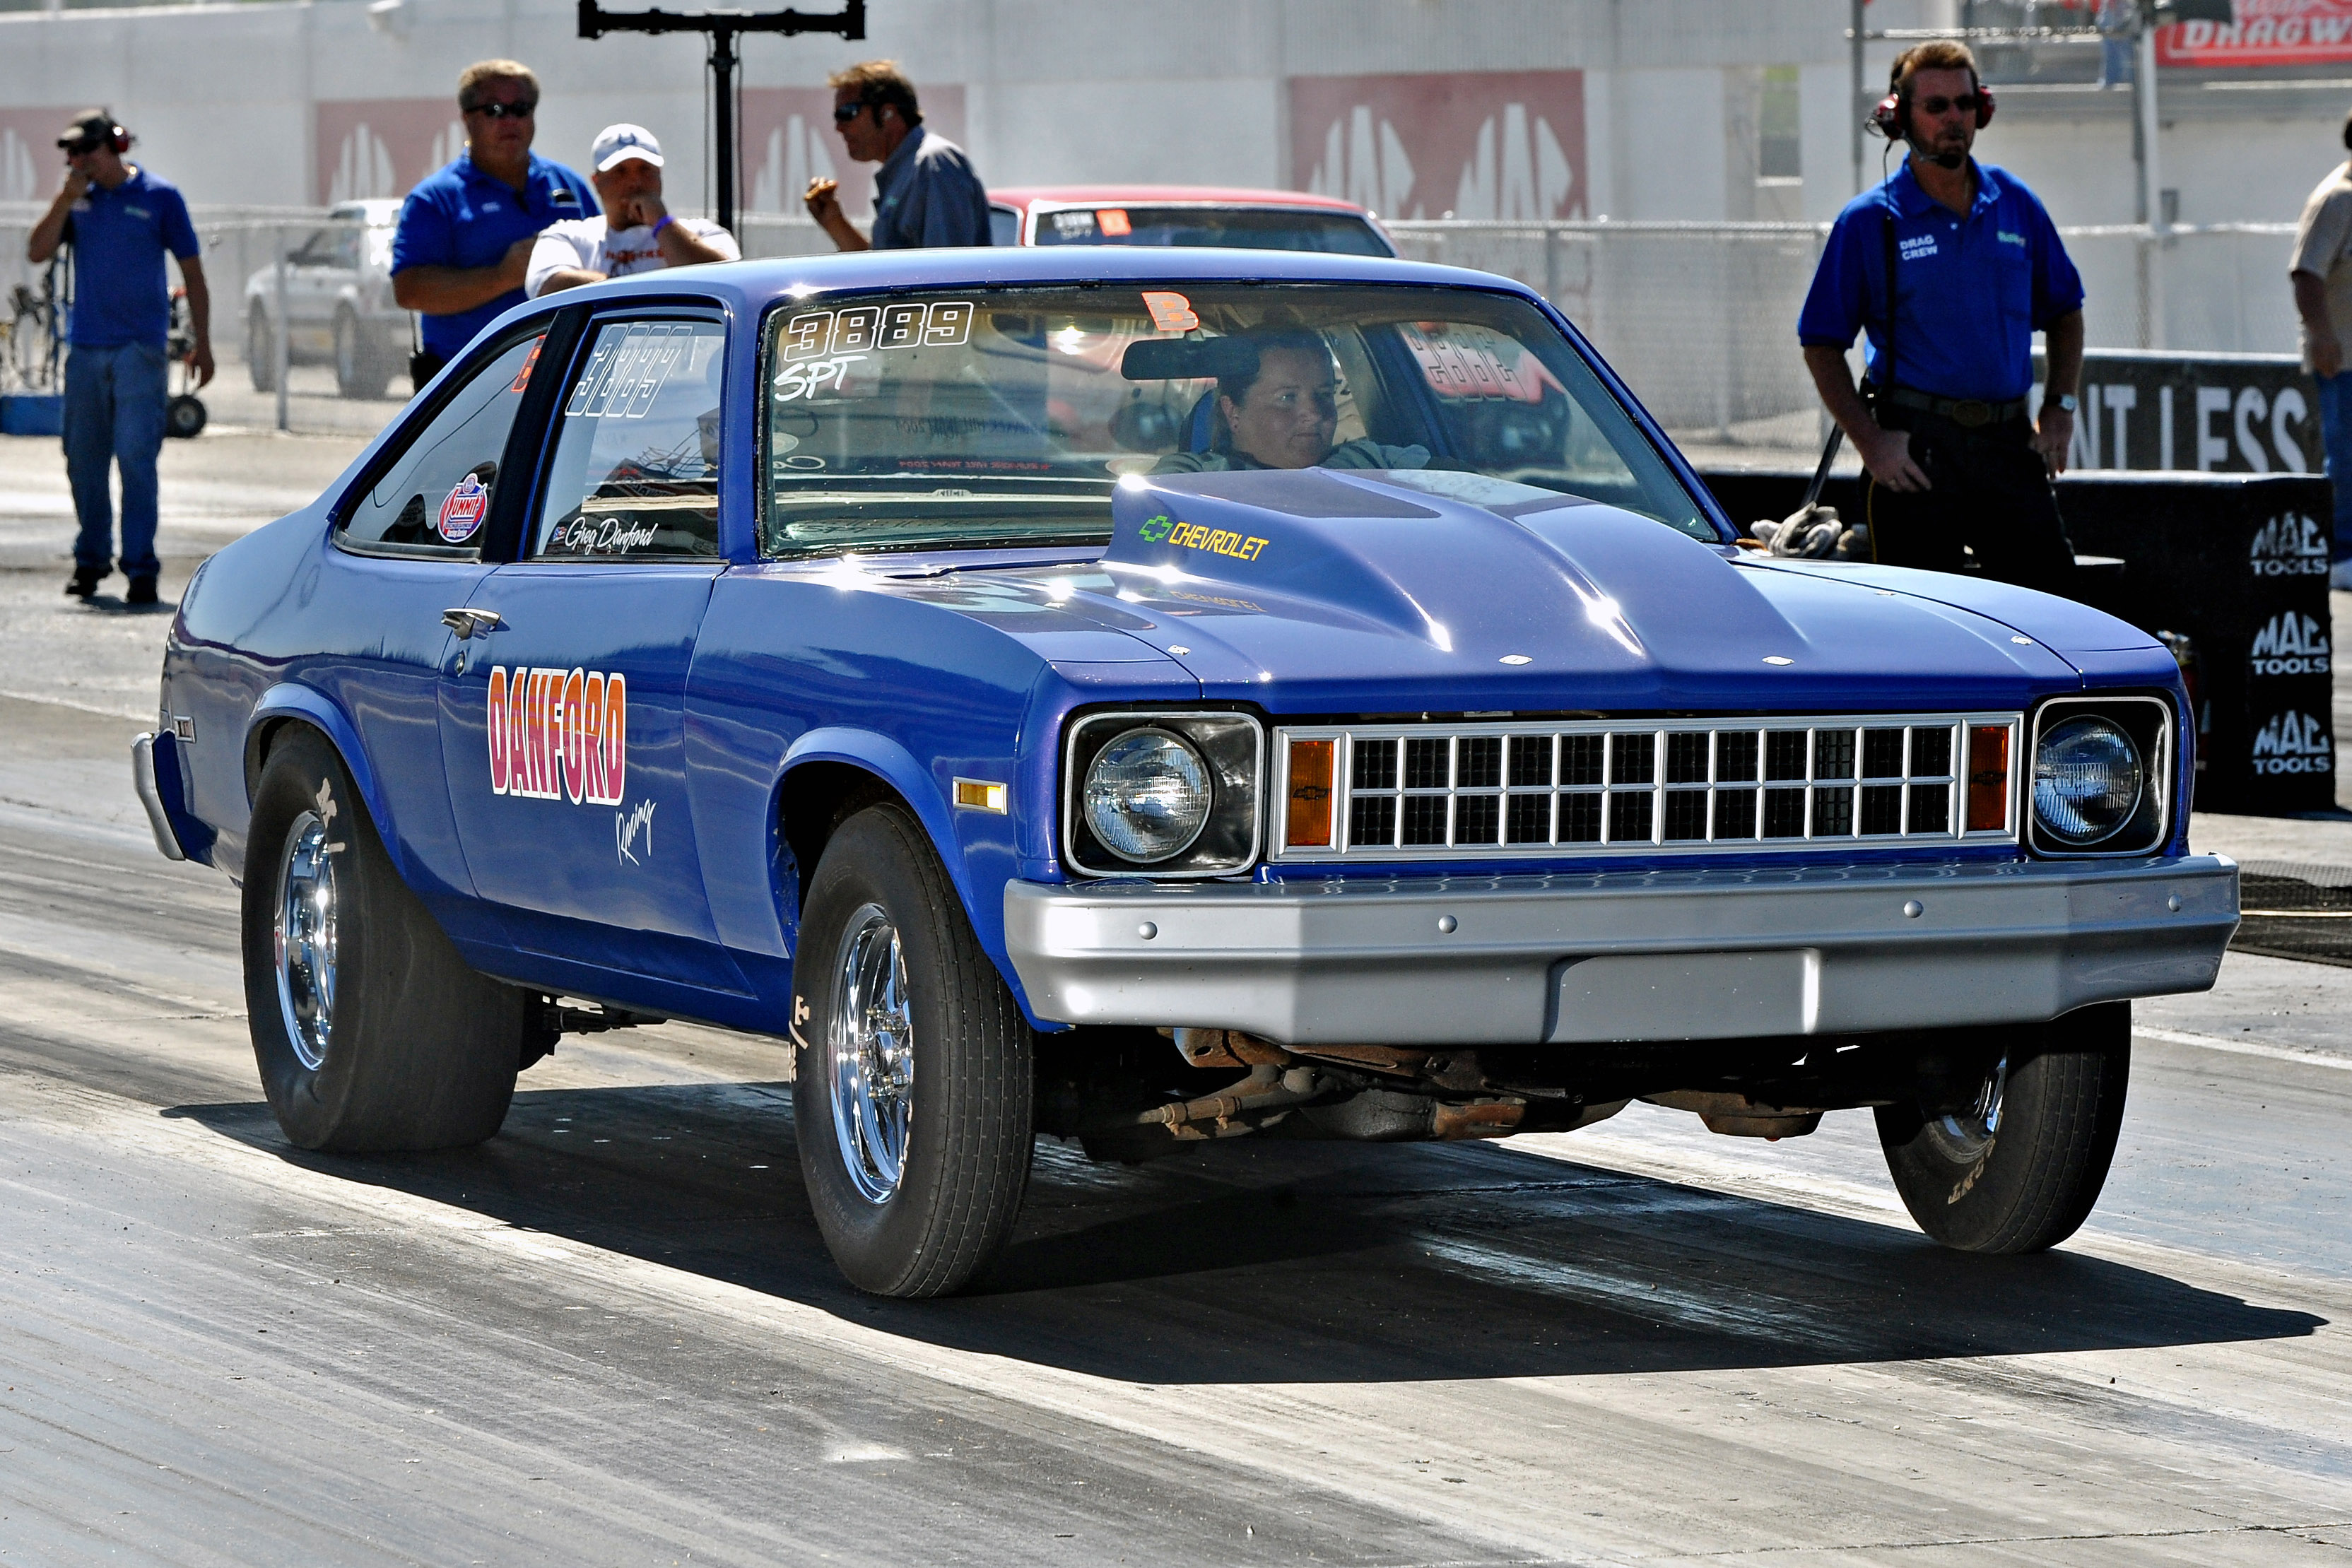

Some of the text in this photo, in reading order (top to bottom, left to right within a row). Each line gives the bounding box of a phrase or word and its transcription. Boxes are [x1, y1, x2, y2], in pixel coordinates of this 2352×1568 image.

[1899, 235, 1934, 251] DRAG
[1902, 245, 1938, 261] CREW
[784, 302, 974, 362] 3889
[1141, 291, 1200, 331] B
[565, 324, 693, 419] 3889
[773, 355, 868, 401] SPT
[565, 517, 659, 555] Greg Danford
[1168, 521, 1270, 561] CHEVROLET
[2250, 511, 2329, 557] MAC
[2250, 558, 2328, 576] TOOLS
[2252, 611, 2329, 656] MAC
[2252, 657, 2329, 676] TOOLS
[487, 666, 626, 806] DANFORD
[2252, 709, 2331, 756] MAC
[2252, 756, 2331, 775] TOOLS
[616, 798, 657, 866] Racing
